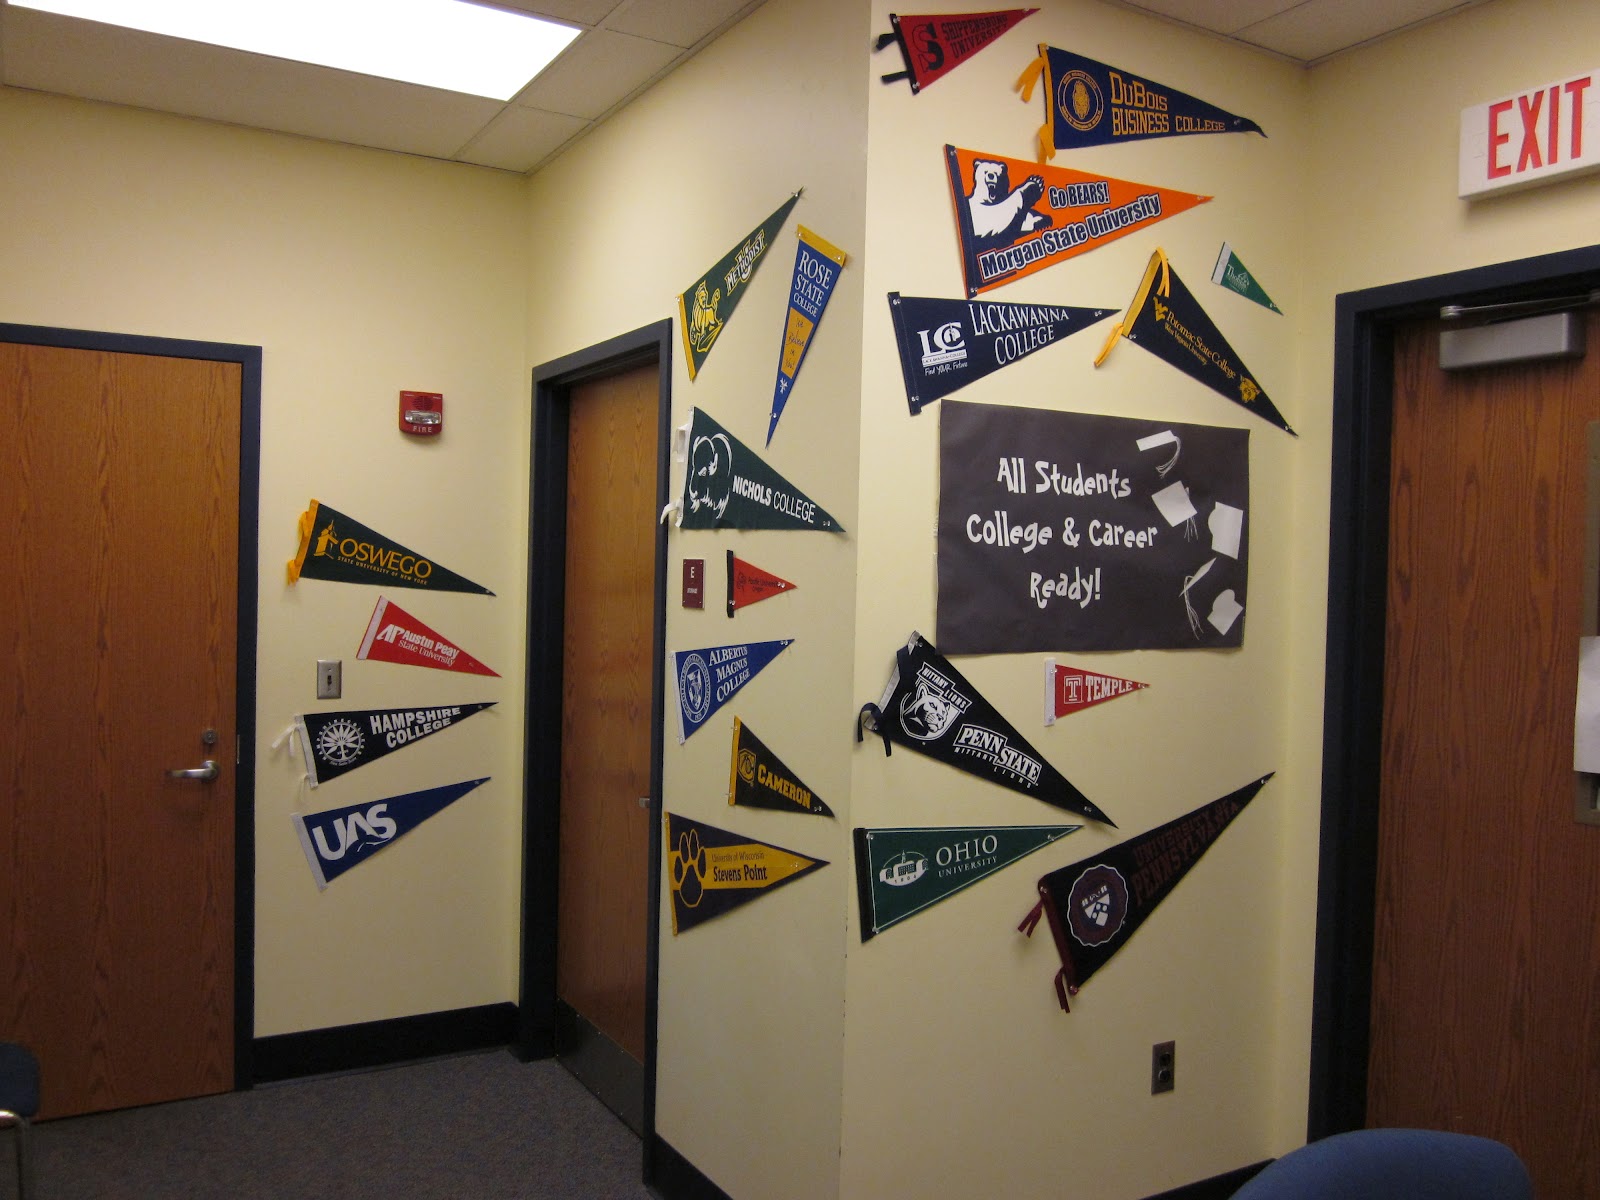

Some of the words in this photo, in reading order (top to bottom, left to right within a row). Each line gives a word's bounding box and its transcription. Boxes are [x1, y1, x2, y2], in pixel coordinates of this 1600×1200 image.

[950, 23, 1008, 59] UNIVERSITY
[1112, 107, 1170, 136] BUSINESS
[1175, 115, 1226, 132] COLLEGE
[1487, 76, 1591, 180] EXIT
[1048, 185, 1067, 210] Go
[1066, 181, 1110, 208] BEARS!
[979, 238, 1046, 281] Morgan
[1043, 222, 1087, 255] State
[1085, 193, 1162, 238] University
[725, 231, 765, 293] METHODIST
[798, 250, 832, 290] ROSE
[793, 292, 819, 318] COLLEGE
[794, 273, 825, 307] STATE
[968, 303, 1070, 337] LACKAWANNA
[994, 324, 1055, 366] COLLEGE
[1167, 311, 1195, 343] Potomac
[1195, 336, 1213, 358] State
[1211, 351, 1236, 379] College
[412, 425, 432, 433] FIRE
[997, 457, 1026, 494] All
[1035, 461, 1131, 500] Students
[732, 475, 772, 507] NICHOLS
[773, 491, 816, 524] COLLEGE
[966, 510, 1053, 554] College
[1062, 517, 1081, 548] &
[1088, 519, 1158, 548] Career
[337, 556, 354, 565] STATE
[355, 560, 390, 574] UNIVERSITY
[414, 578, 428, 586] YORK
[339, 538, 432, 579] OSWEGO
[1030, 566, 1101, 609] Ready!
[398, 639, 419, 653] State
[419, 646, 455, 667] University
[402, 629, 434, 650] Austin
[434, 641, 460, 660] Peay
[709, 646, 748, 667] ALBERTUS
[716, 658, 748, 683] MAGNUS
[716, 668, 750, 702] COLLEGE
[921, 667, 949, 689] NITTANY
[944, 689, 967, 709] LIONS
[1085, 675, 1133, 702] TEMPLE
[369, 706, 462, 735] HAMPSHIRE
[386, 717, 451, 749] COLLEGE
[954, 747, 993, 762] NITTANY
[993, 766, 1032, 789] LIONS
[958, 727, 1004, 754] PENN
[997, 747, 1040, 781] STATE
[757, 763, 811, 809] CAMERON
[312, 803, 397, 861] UAS
[739, 851, 765, 861] Wisconsin
[936, 834, 998, 867] OHIO
[938, 855, 998, 878] UNIVERSITY
[713, 866, 742, 882] Stevens
[743, 864, 768, 881] Point
